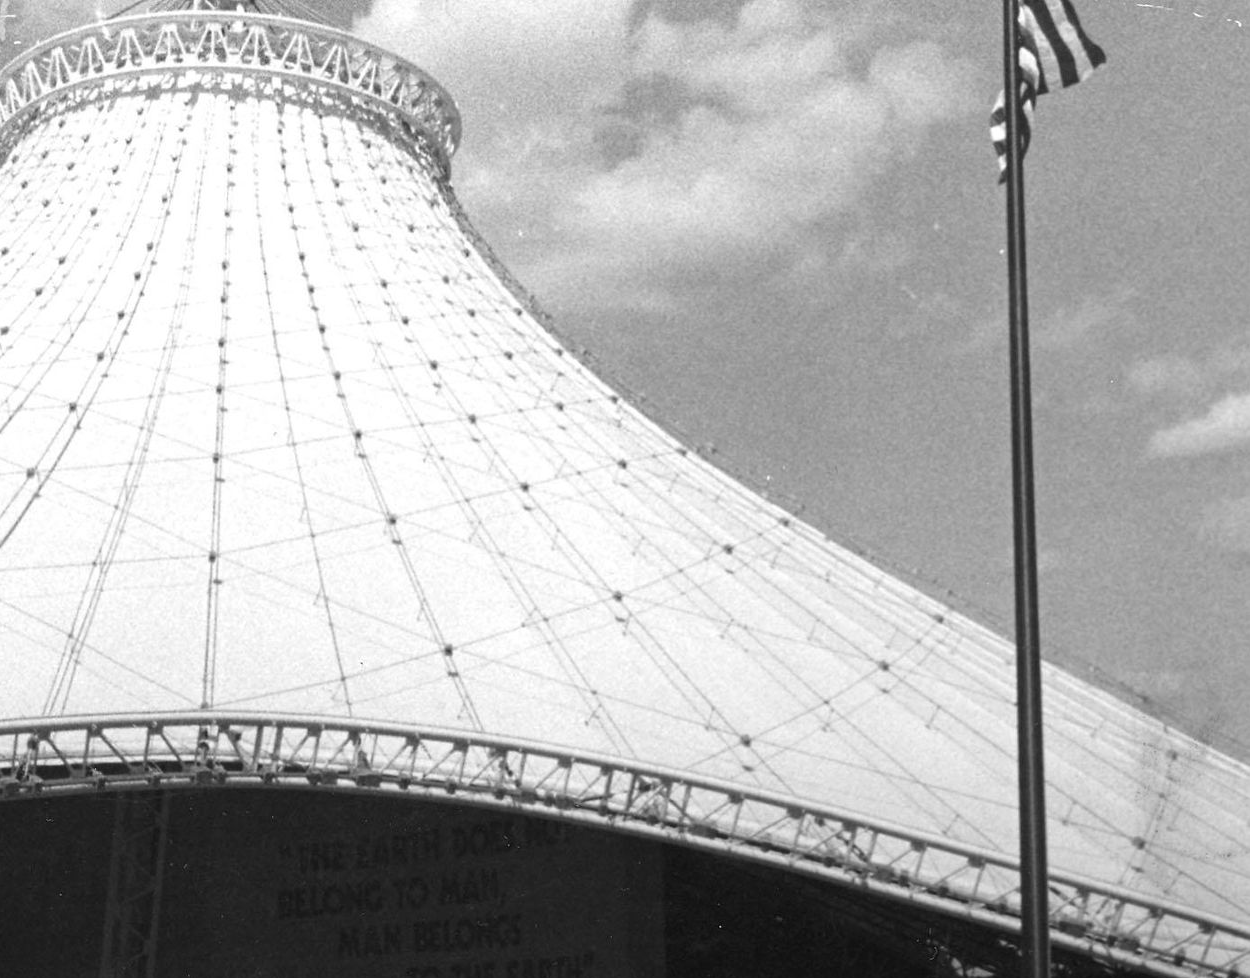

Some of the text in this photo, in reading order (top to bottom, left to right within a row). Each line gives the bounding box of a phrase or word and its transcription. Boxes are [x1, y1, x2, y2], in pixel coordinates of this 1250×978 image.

[278, 879, 384, 920] BELONG
[393, 876, 429, 910] TO
[338, 913, 522, 958] MAN BELONGS
